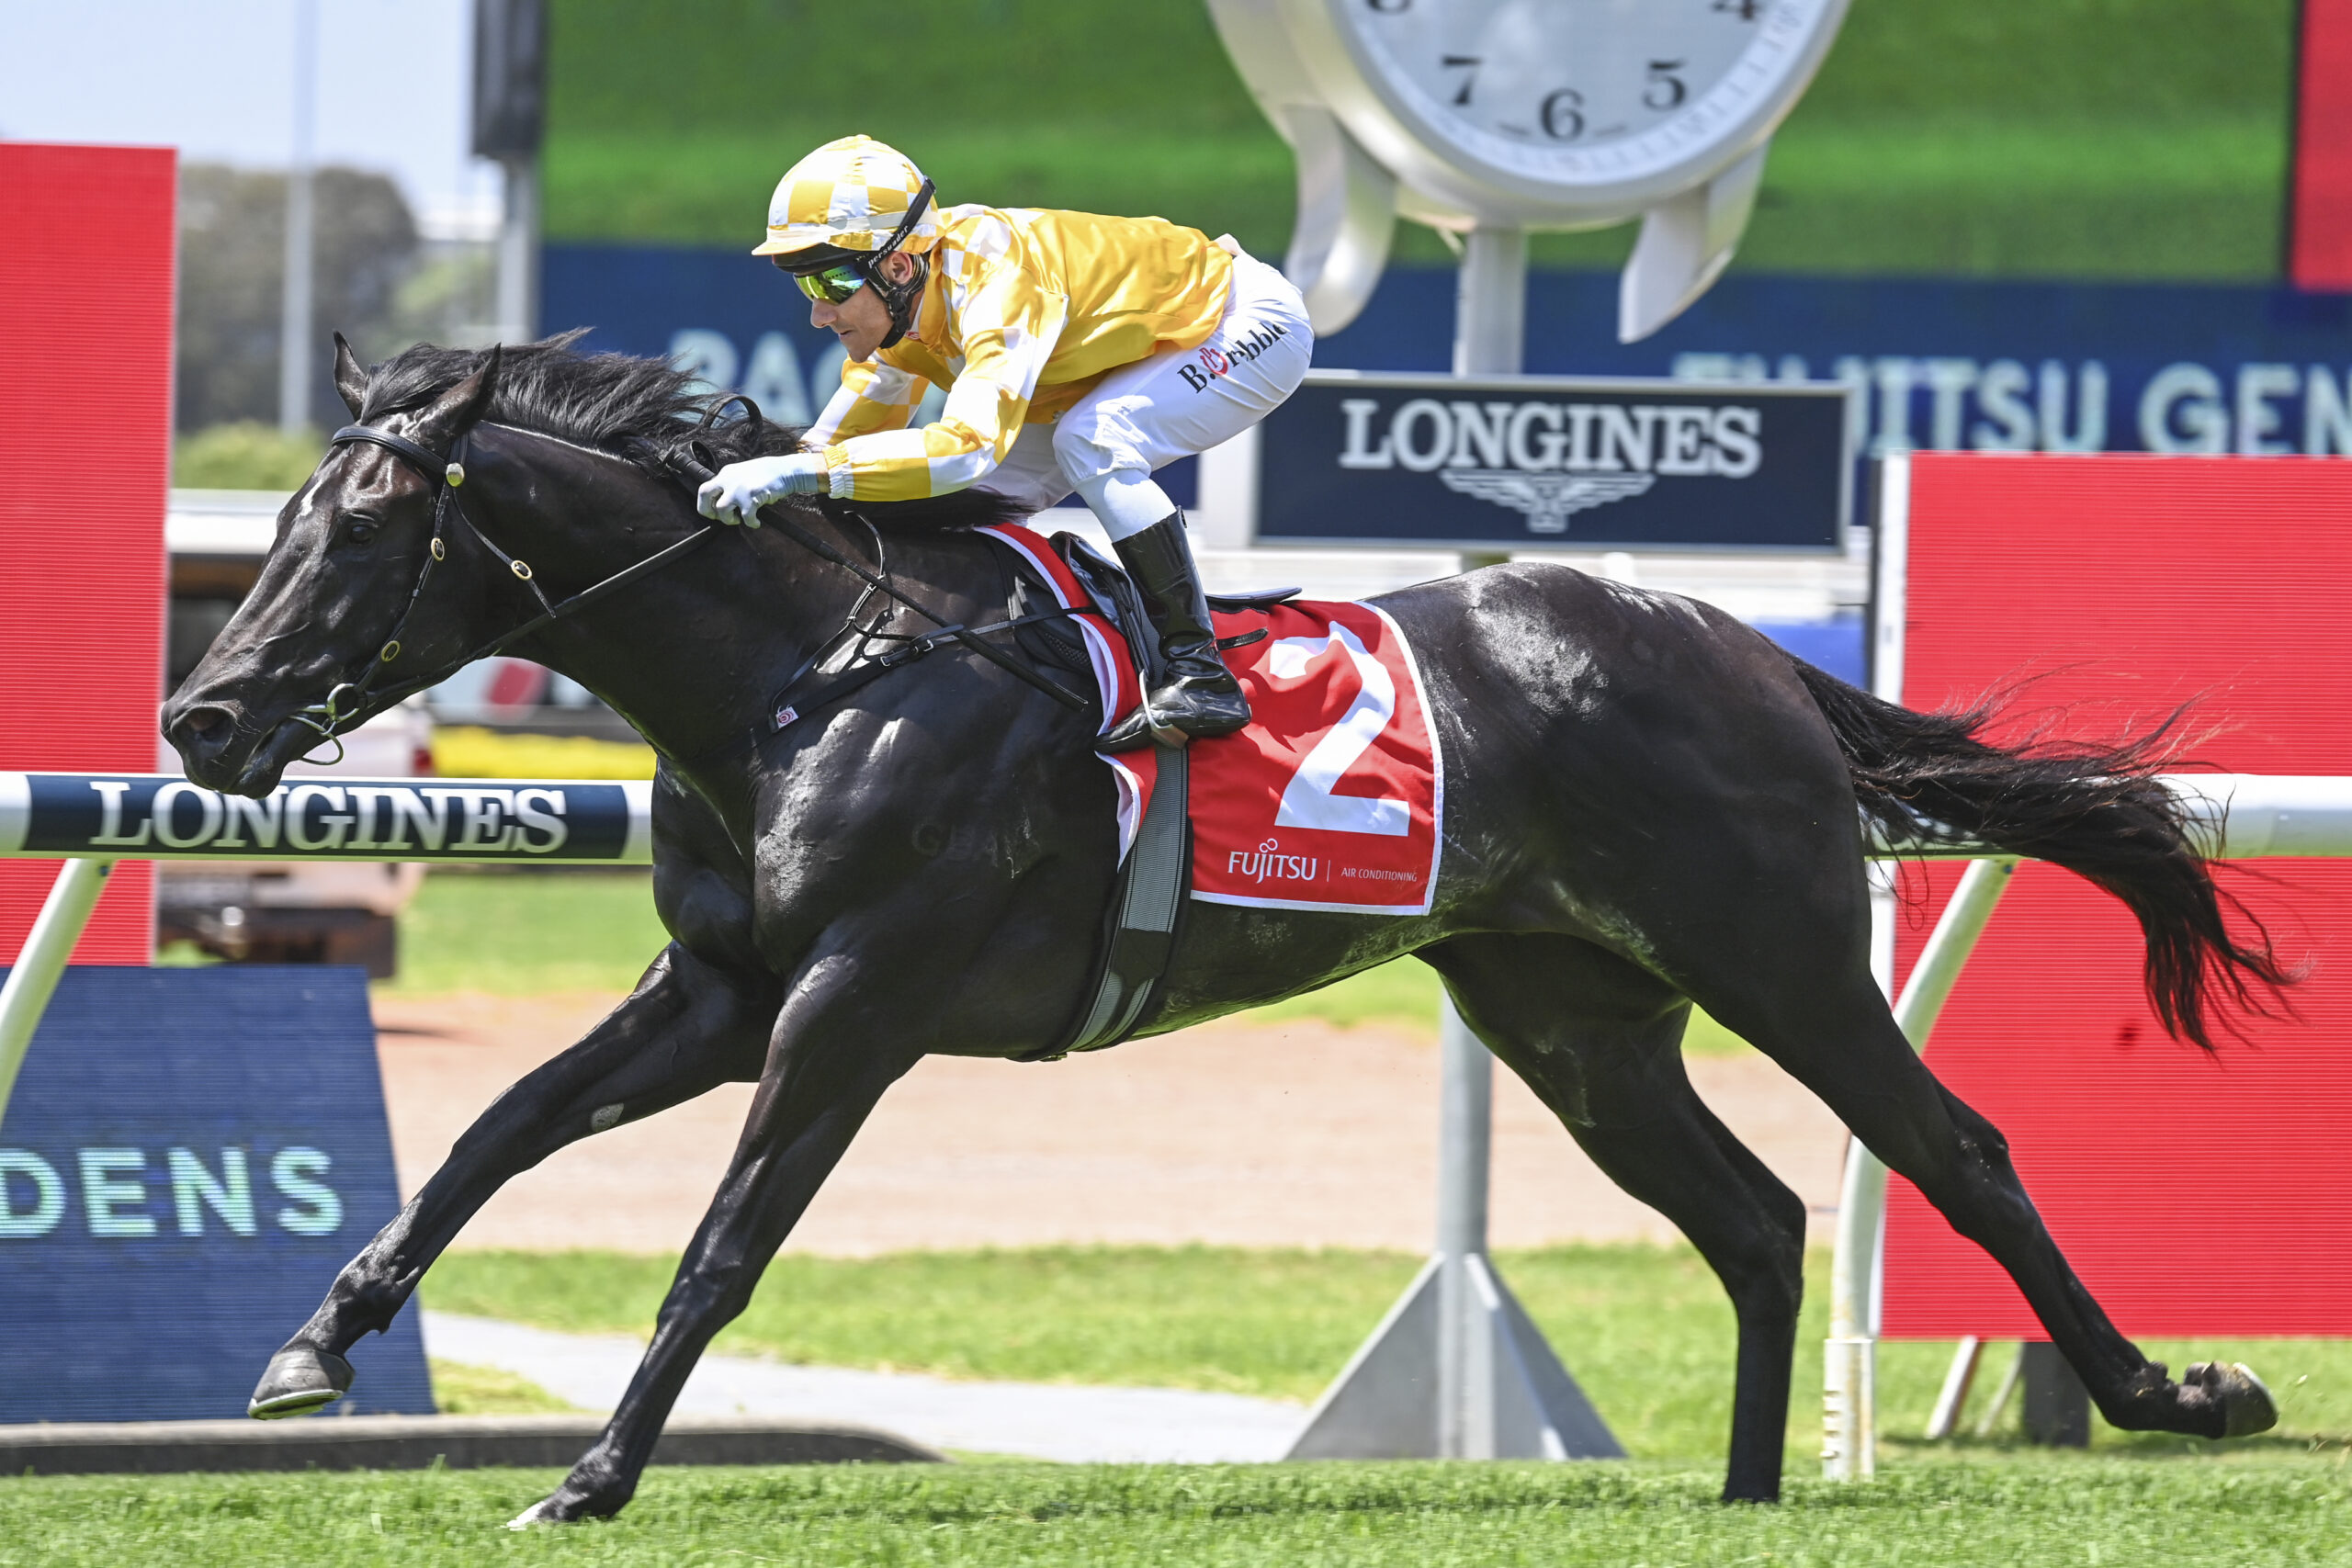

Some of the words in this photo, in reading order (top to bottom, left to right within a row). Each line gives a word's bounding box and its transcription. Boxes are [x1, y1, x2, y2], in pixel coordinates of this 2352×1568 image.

[1441, 56, 1483, 107] 7
[1644, 61, 1688, 111] 5
[1539, 89, 1585, 140] 6
[868, 225, 908, 269] persuader
[1340, 399, 1762, 478] LONGINES
[1270, 620, 1410, 837] 2
[88, 781, 569, 854] LONGINES
[1227, 849, 1317, 884] FUJITSU
[1340, 867, 1357, 878] AIR
[1358, 868, 1418, 883] CONDITIONING
[0, 1146, 344, 1238] DENS
